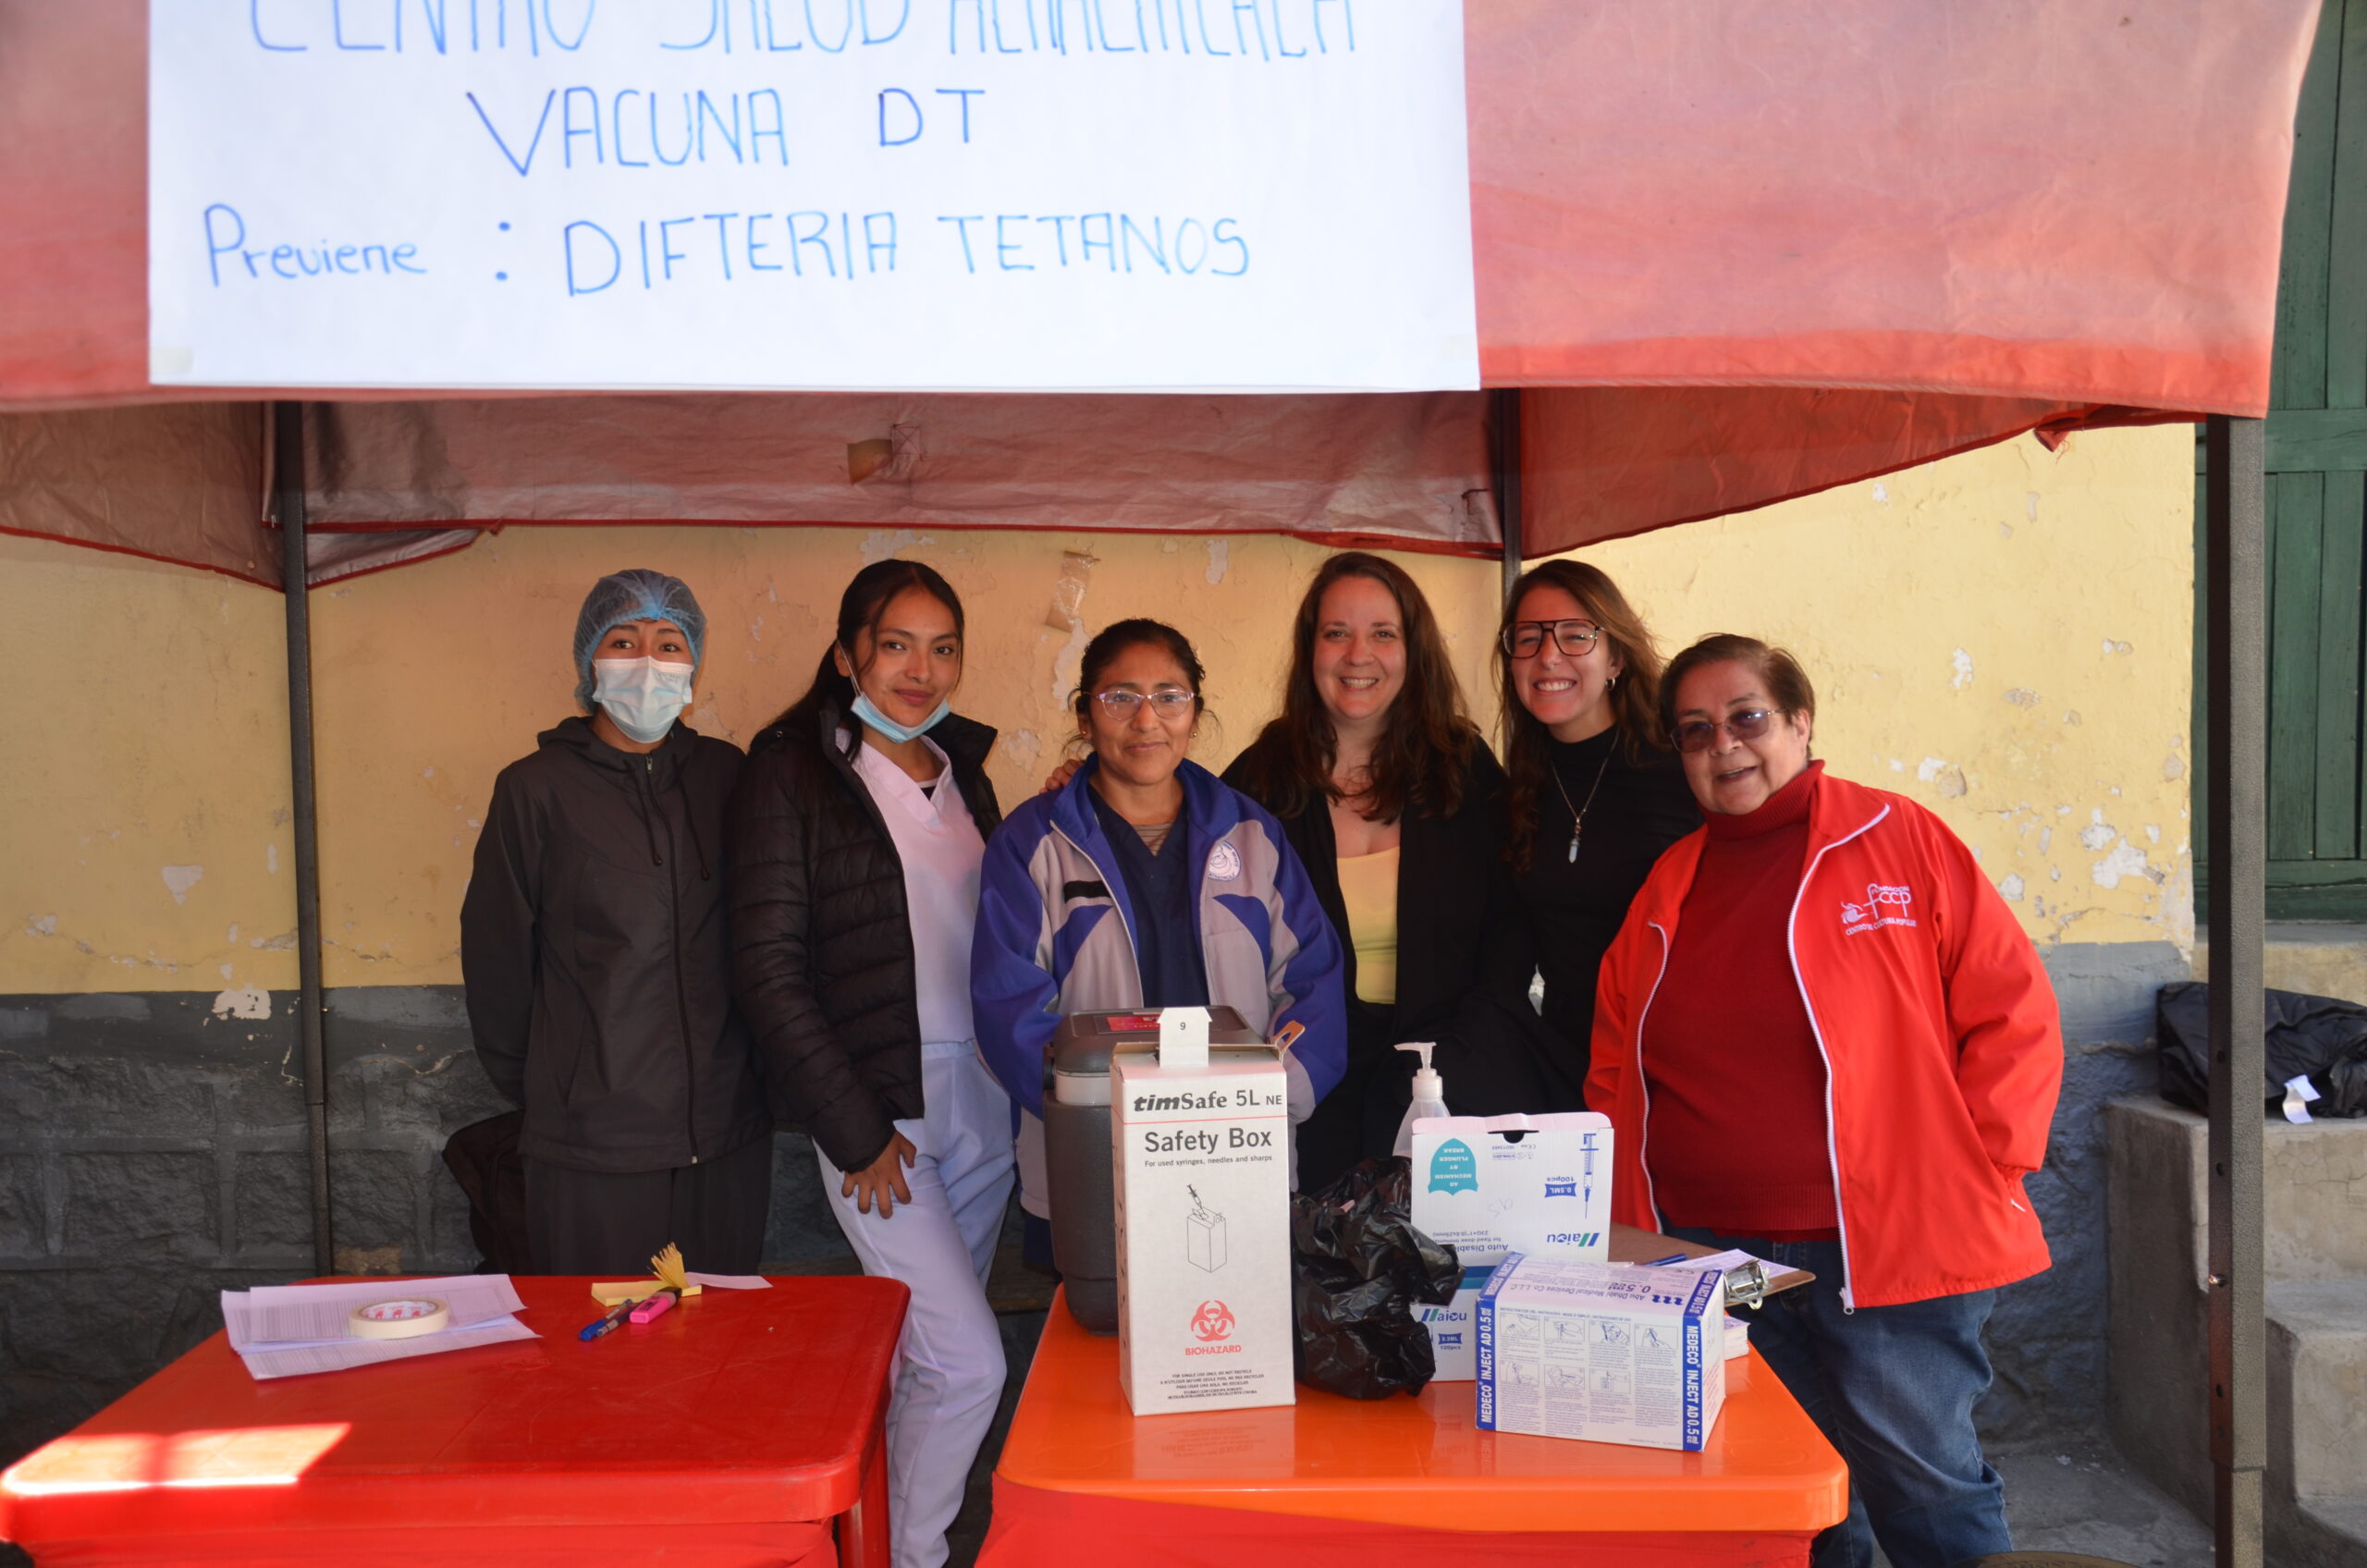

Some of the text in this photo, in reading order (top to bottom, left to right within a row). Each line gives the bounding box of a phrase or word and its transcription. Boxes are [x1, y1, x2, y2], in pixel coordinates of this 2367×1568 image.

[465, 85, 790, 178] VACUNA
[202, 202, 428, 288] Previene
[563, 211, 898, 298] DIFTERIA
[937, 212, 1250, 276] TETANOS
[1180, 1022, 1186, 1031] 9
[1134, 1089, 1282, 1112] timSafe 5L NE
[1144, 1127, 1272, 1155] Safety Box
[1176, 1158, 1206, 1167] syringes,
[1250, 1155, 1272, 1163] sharps
[1454, 1244, 1485, 1253] Disabl
[1576, 1289, 1605, 1297] Medical
[1480, 1331, 1491, 1346] AD
[1184, 1344, 1242, 1356] BIOHAZARD
[1480, 1347, 1492, 1380] INJECT
[1686, 1369, 1699, 1403] INJECT
[1686, 1404, 1699, 1419] AD
[1686, 1419, 1699, 1435] 0.5
